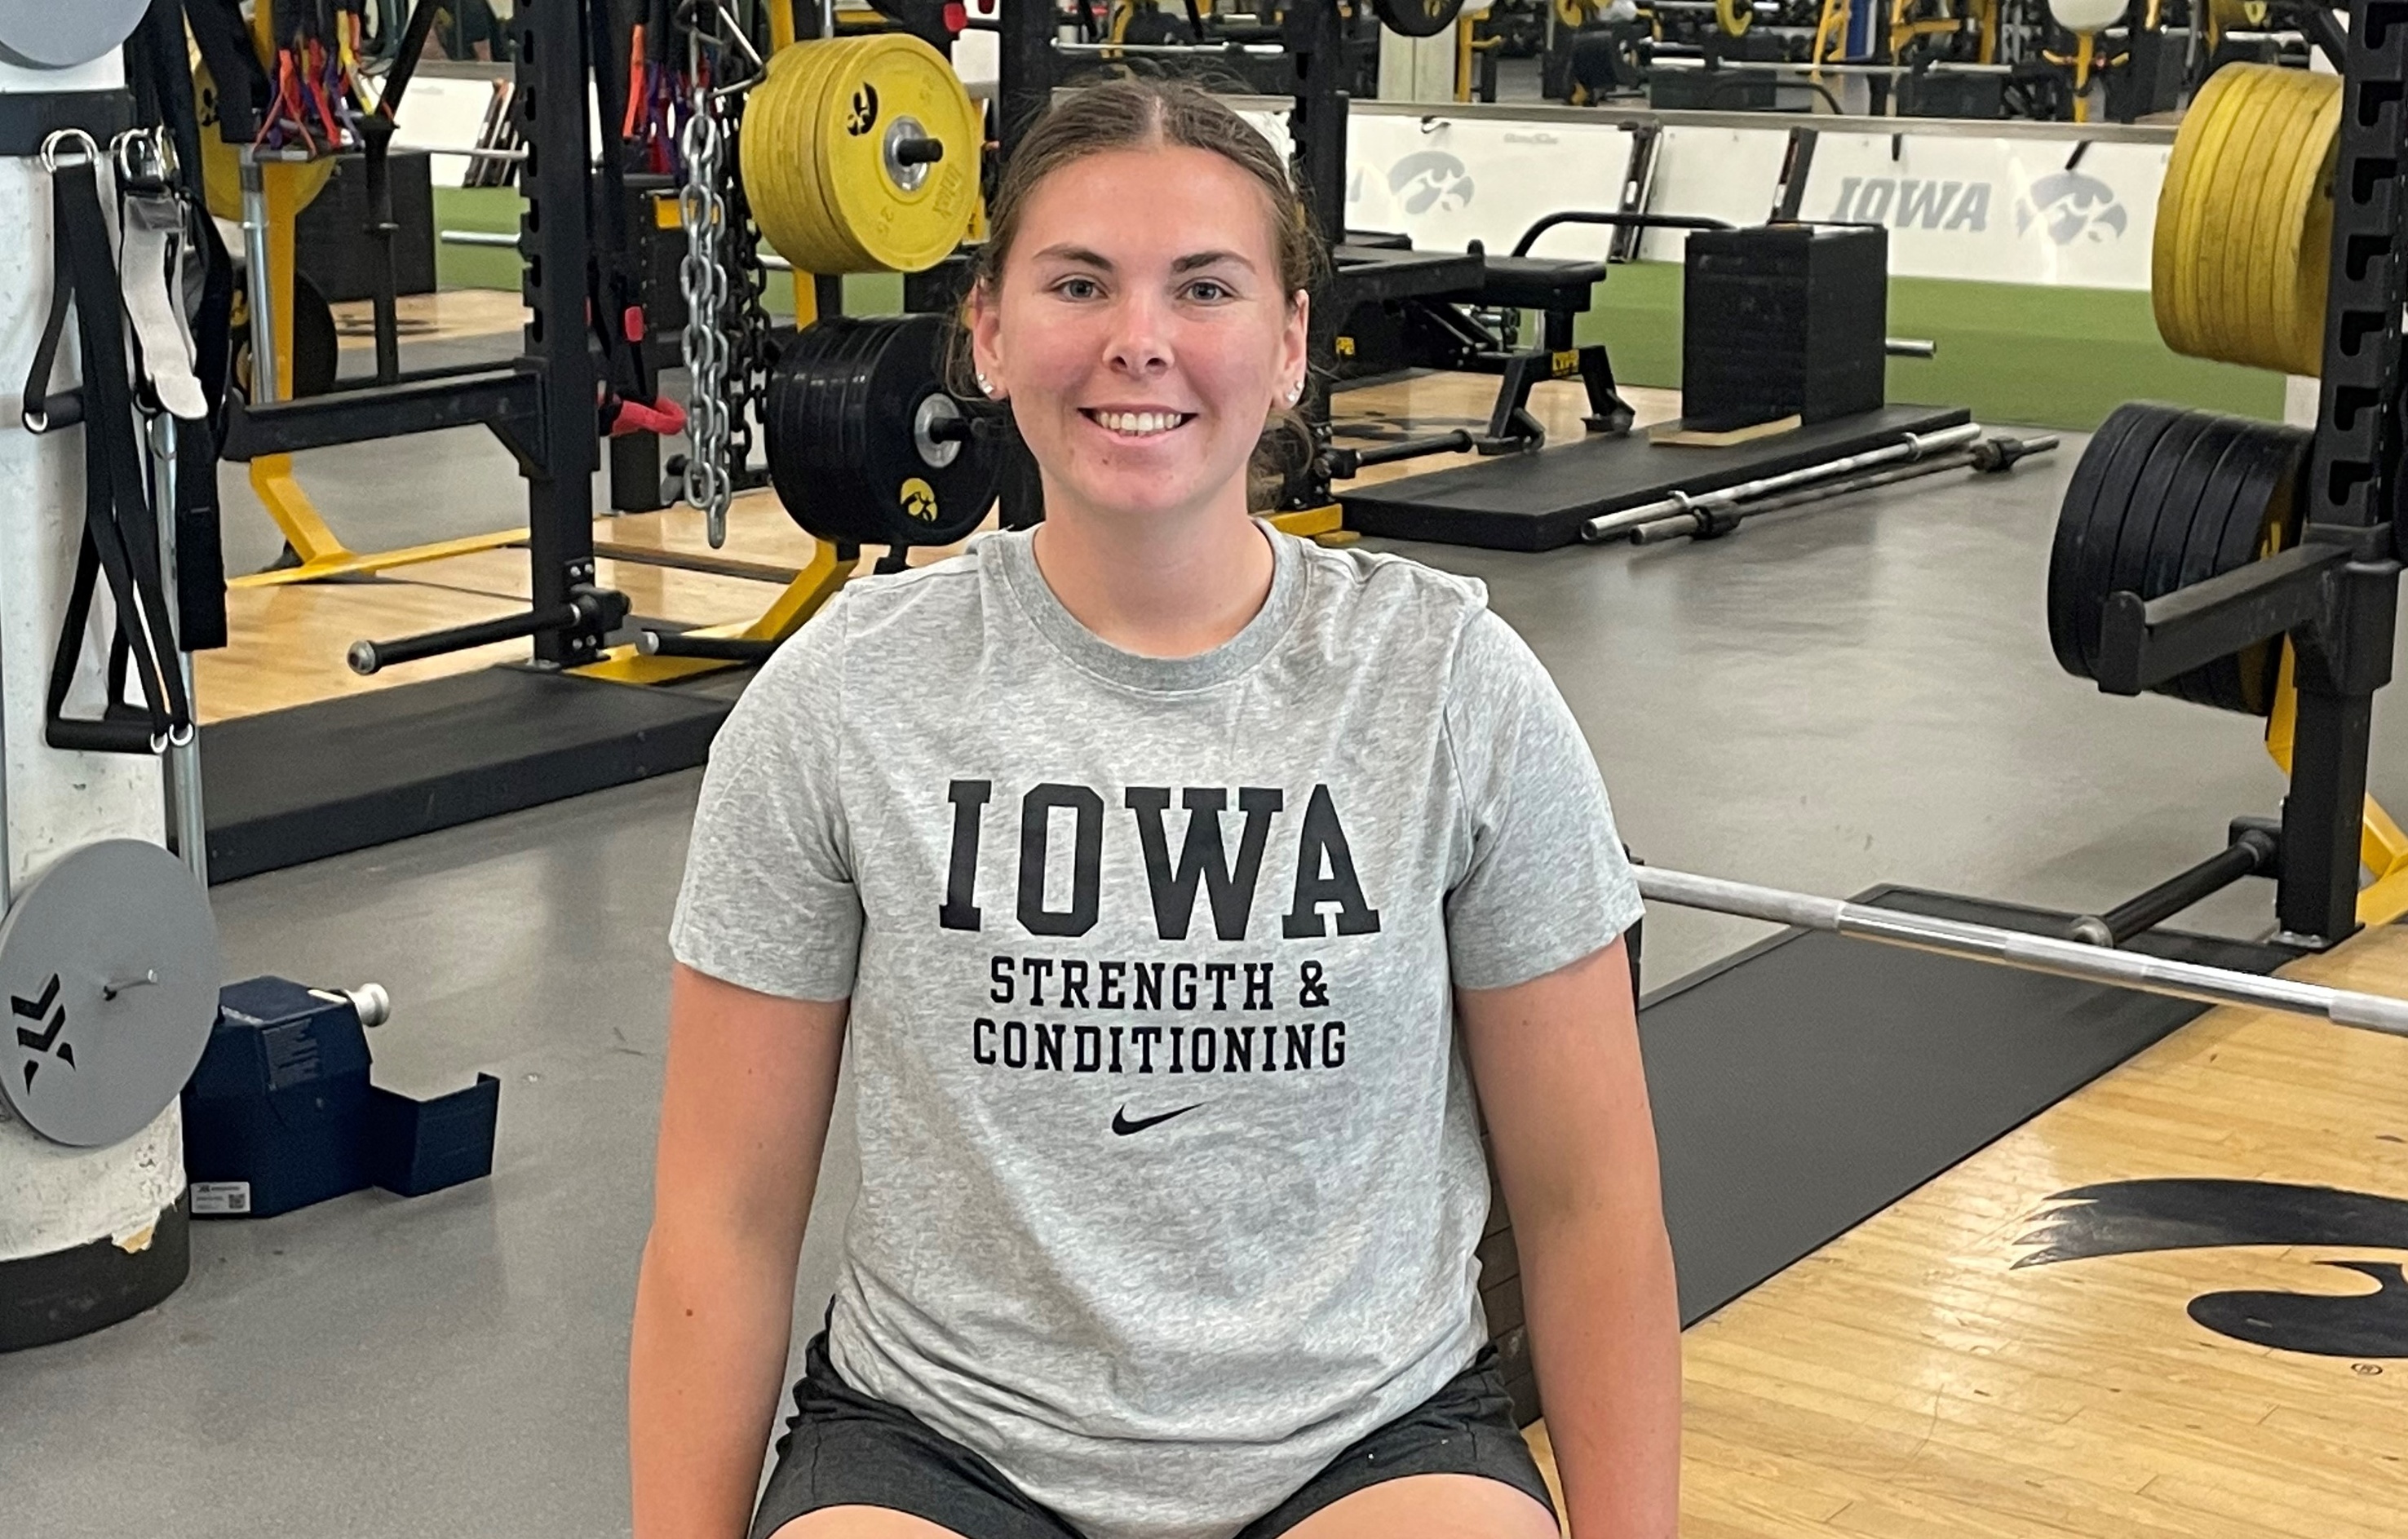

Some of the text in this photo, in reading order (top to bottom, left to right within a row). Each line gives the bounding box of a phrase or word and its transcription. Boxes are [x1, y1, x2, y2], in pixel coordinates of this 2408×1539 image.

[1828, 177, 1992, 232] IOWA
[940, 781, 1381, 941] IOWA
[990, 956, 1330, 1011] STRENGTH &
[973, 1018, 1347, 1074] CONDITIONING
